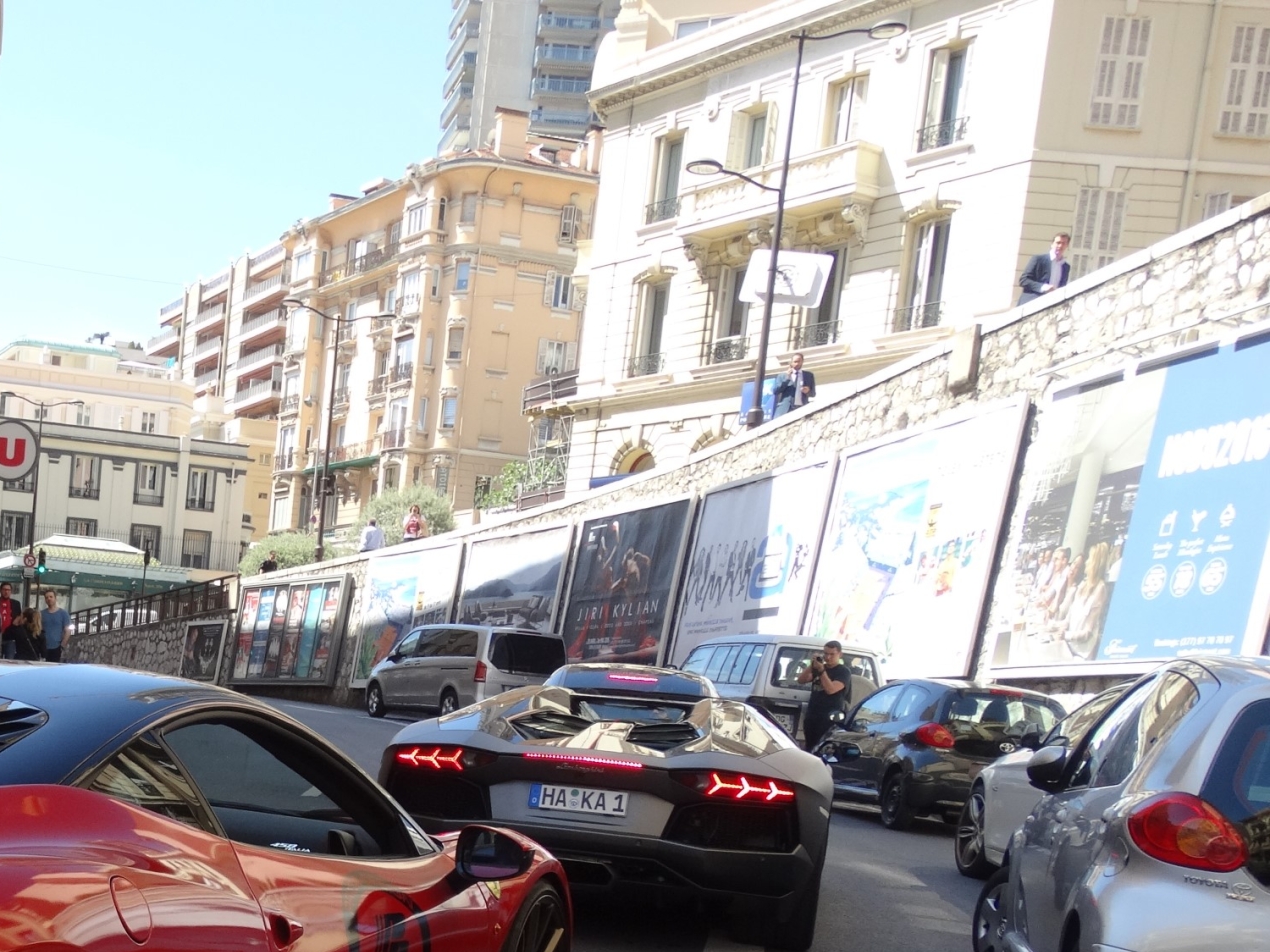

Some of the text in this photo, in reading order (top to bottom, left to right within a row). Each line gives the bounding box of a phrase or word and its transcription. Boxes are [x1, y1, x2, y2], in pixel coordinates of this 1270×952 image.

[612, 599, 660, 619] KYLIAN
[541, 787, 567, 807] HA
[580, 790, 606, 811] KA
[612, 794, 624, 813] 1
[1183, 874, 1229, 889] TOYOTA
